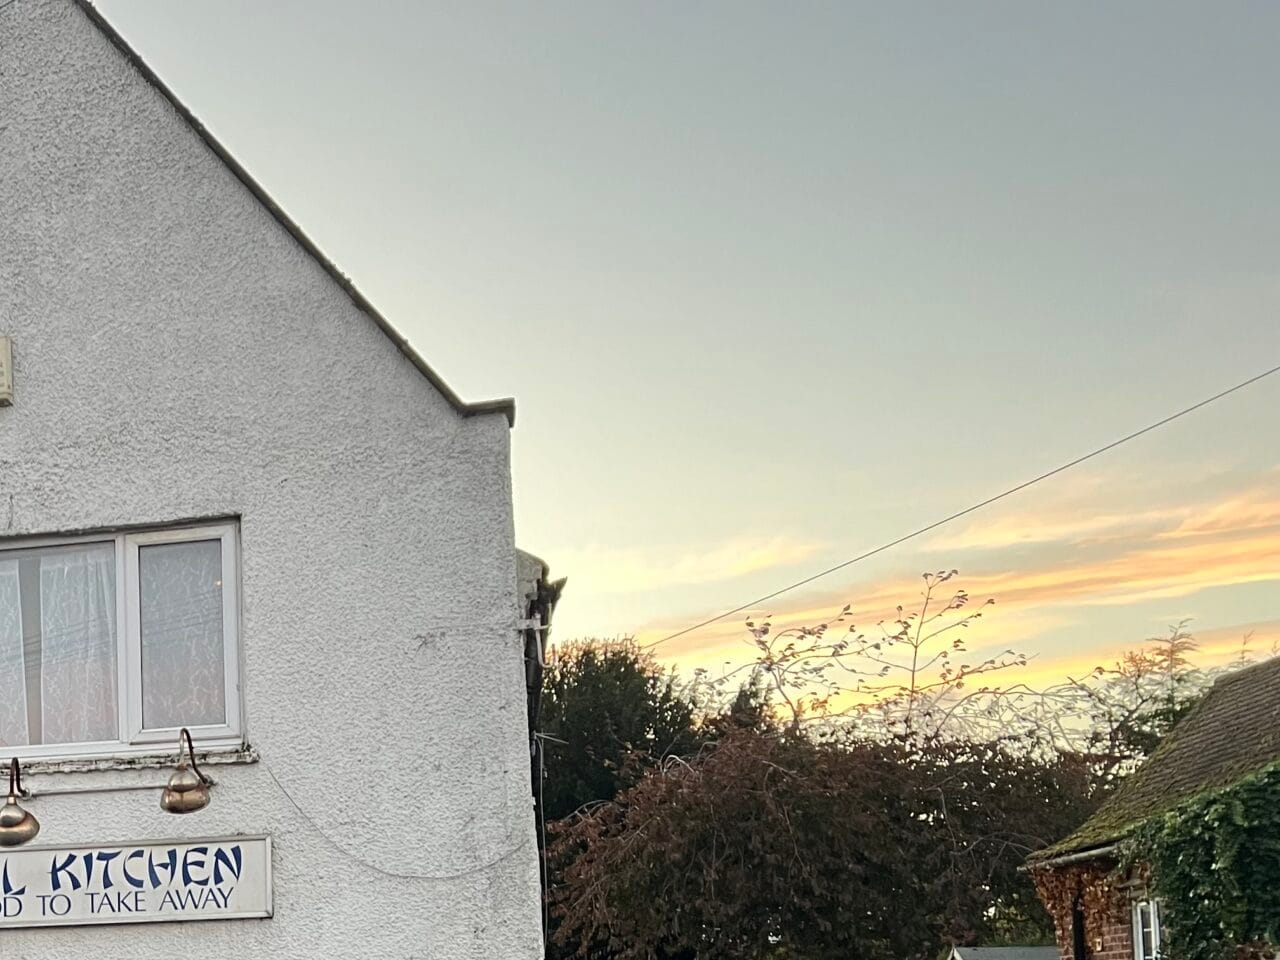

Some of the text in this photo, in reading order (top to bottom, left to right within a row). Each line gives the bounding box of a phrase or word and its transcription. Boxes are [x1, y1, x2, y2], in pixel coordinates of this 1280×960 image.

[48, 845, 242, 892] KITCHEN
[36, 894, 72, 916] TO
[85, 890, 146, 914] TAKE
[159, 886, 234, 912] AWAY
